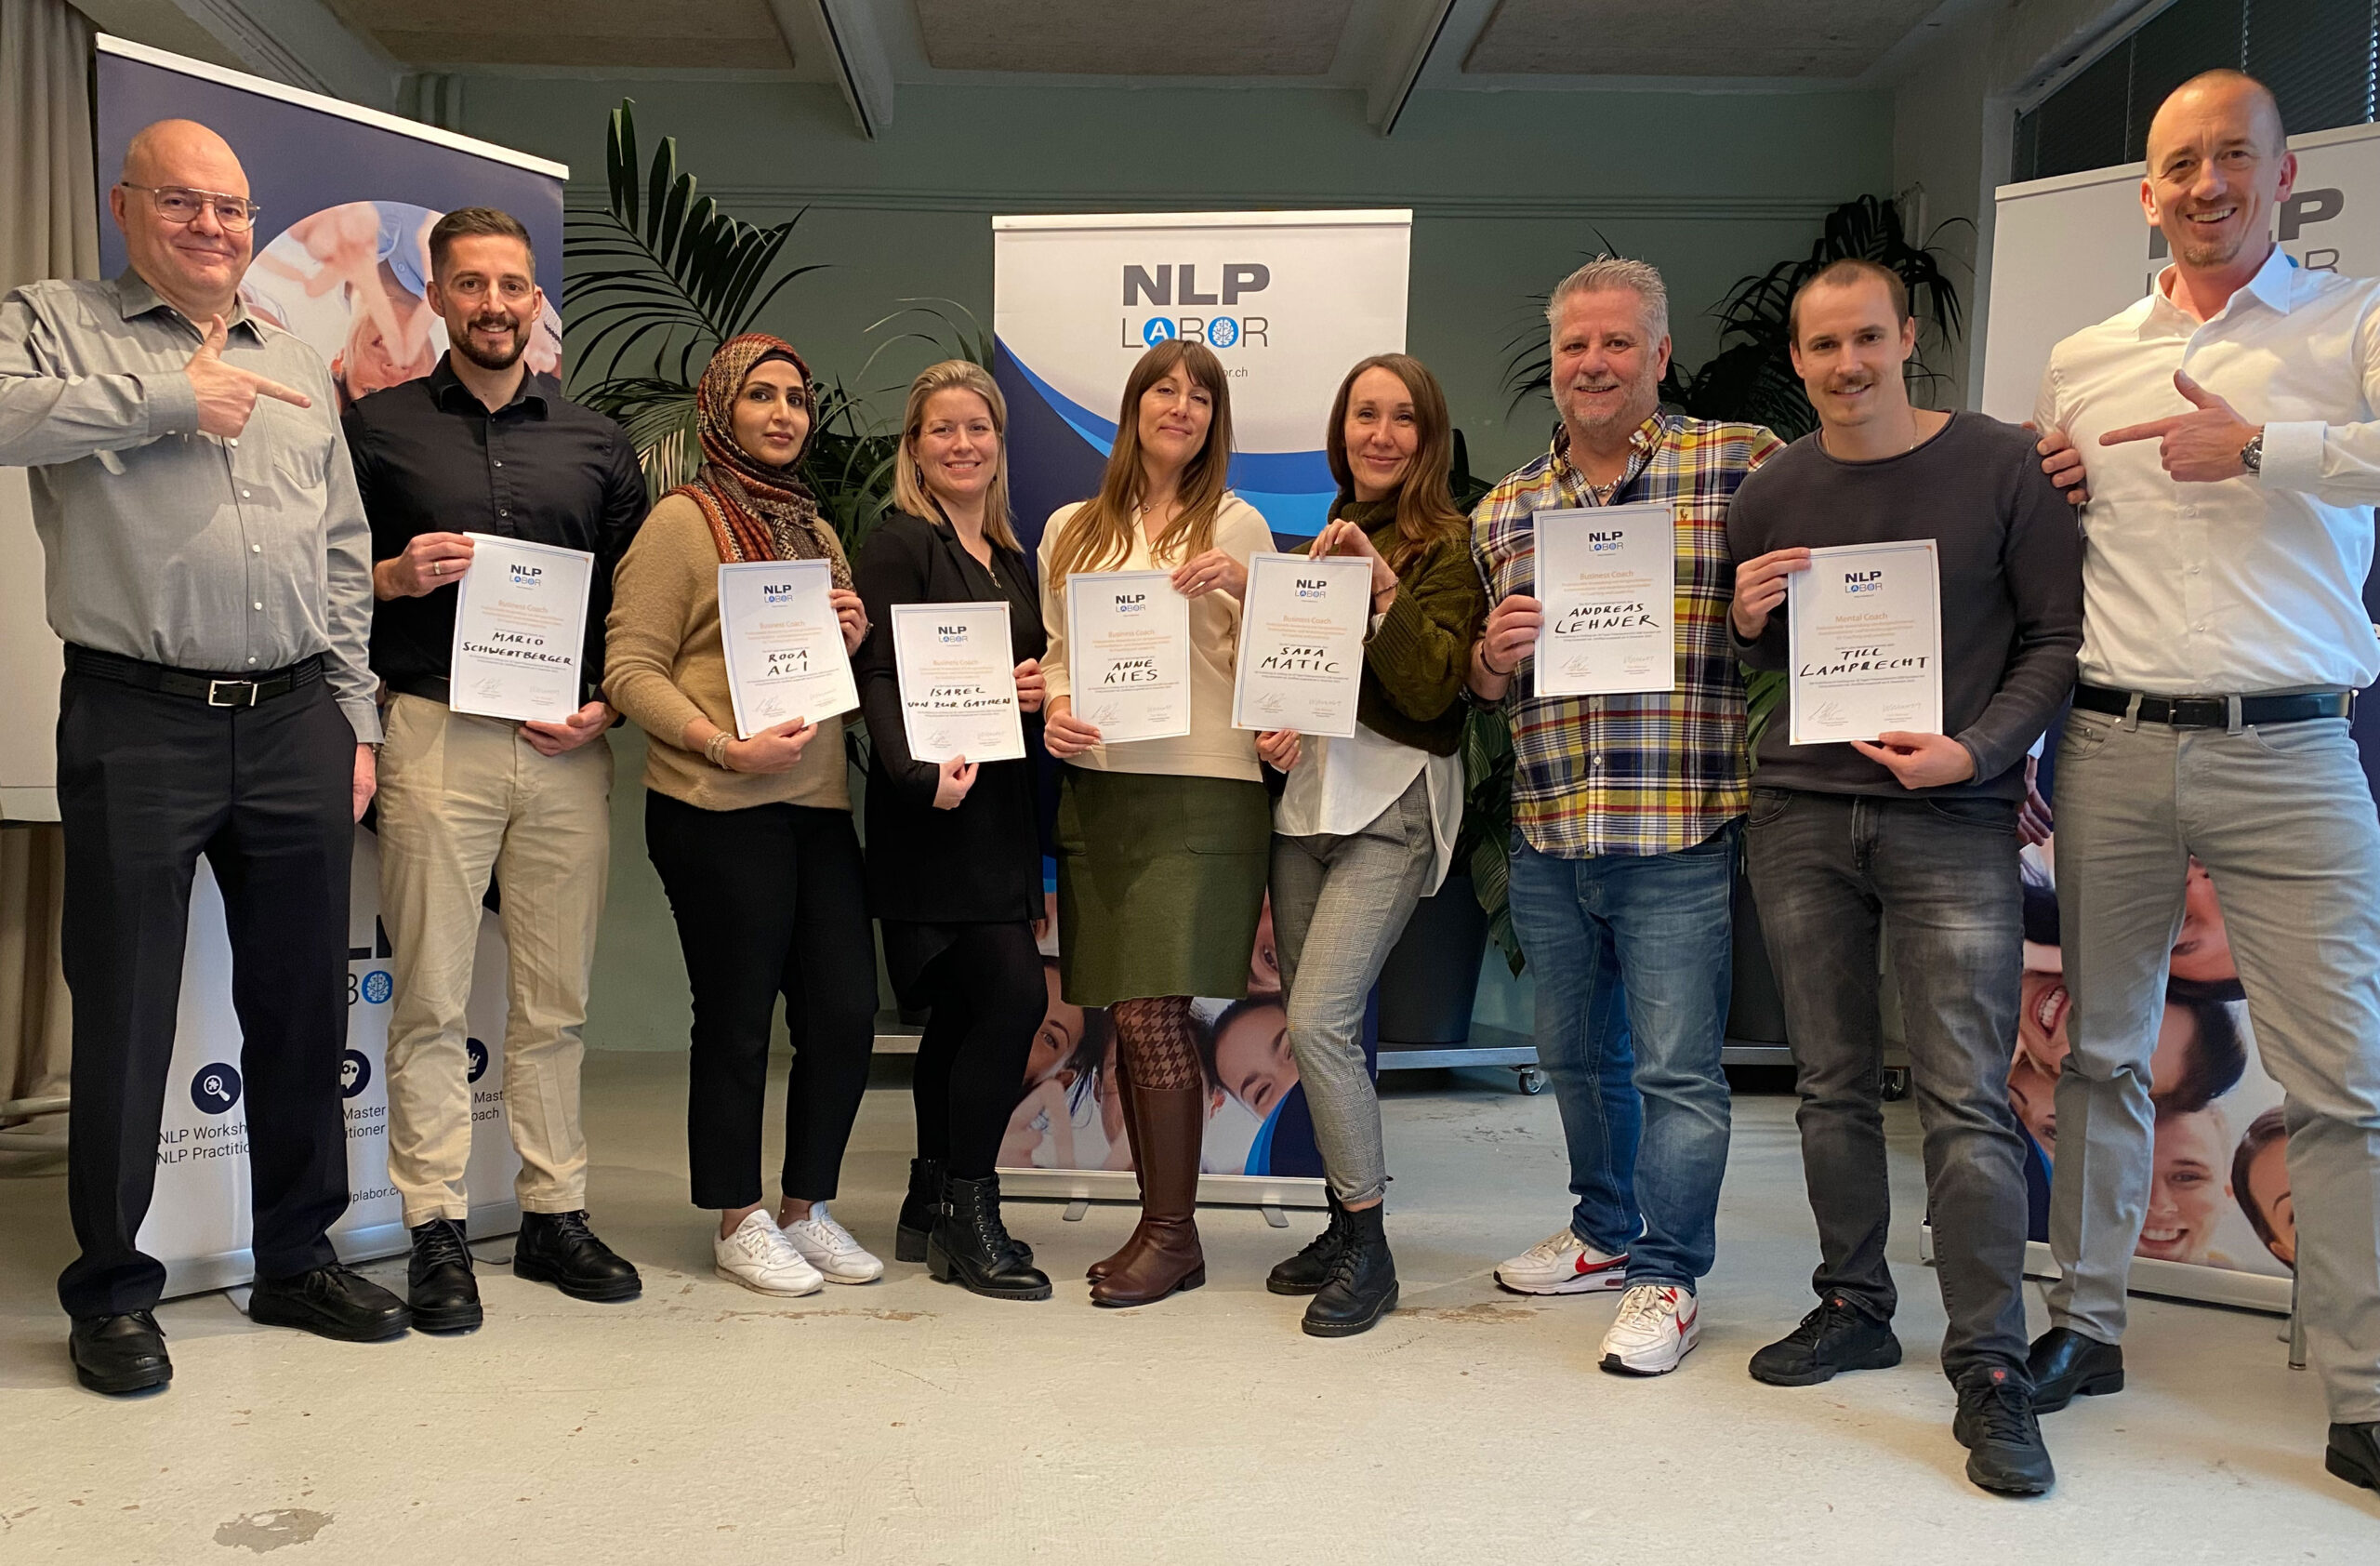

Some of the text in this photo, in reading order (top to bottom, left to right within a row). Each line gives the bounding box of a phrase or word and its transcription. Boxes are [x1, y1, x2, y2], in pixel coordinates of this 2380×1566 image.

[1122, 263, 1271, 307] NLP
[1121, 316, 1269, 349] LABOR
[1589, 531, 1623, 542] NLP
[1588, 542, 1624, 551] LABOR
[510, 564, 542, 577] NLP
[1611, 570, 1633, 578] Coach
[1844, 571, 1882, 583] NLP
[509, 575, 541, 586] LABOR
[1295, 579, 1327, 589] NLP
[763, 584, 792, 594] NLP
[1294, 590, 1326, 599] LABOR
[1844, 583, 1883, 593] LABOR
[763, 594, 793, 604] LABOR
[1116, 594, 1145, 604] NLP
[1115, 604, 1146, 613] LABOR
[1568, 603, 1645, 617] ANDREAS
[1554, 614, 1659, 634] LEHNER
[1835, 613, 1888, 623] Mental Coach
[938, 626, 967, 635] NLP
[491, 631, 544, 646] MARIO
[462, 642, 574, 667] SCHWERTBERGER
[768, 649, 808, 663] ROOA
[1279, 646, 1324, 657] SARA
[1840, 647, 1884, 661] TILL
[767, 661, 808, 677] ALI
[1111, 658, 1153, 671] ANNE
[1261, 656, 1342, 673] MATIC
[1799, 656, 1930, 678] LAMPRECHT
[1104, 669, 1158, 684] KIES
[930, 686, 986, 697] ISABEL
[963, 697, 1011, 708] GATHEN
[474, 1090, 504, 1104] Mast
[343, 1106, 386, 1121] Master
[470, 1107, 499, 1121] oach
[158, 1121, 248, 1145] NLP Worksh
[345, 1124, 386, 1139] itioner
[156, 1141, 250, 1165] NLP Practitio
